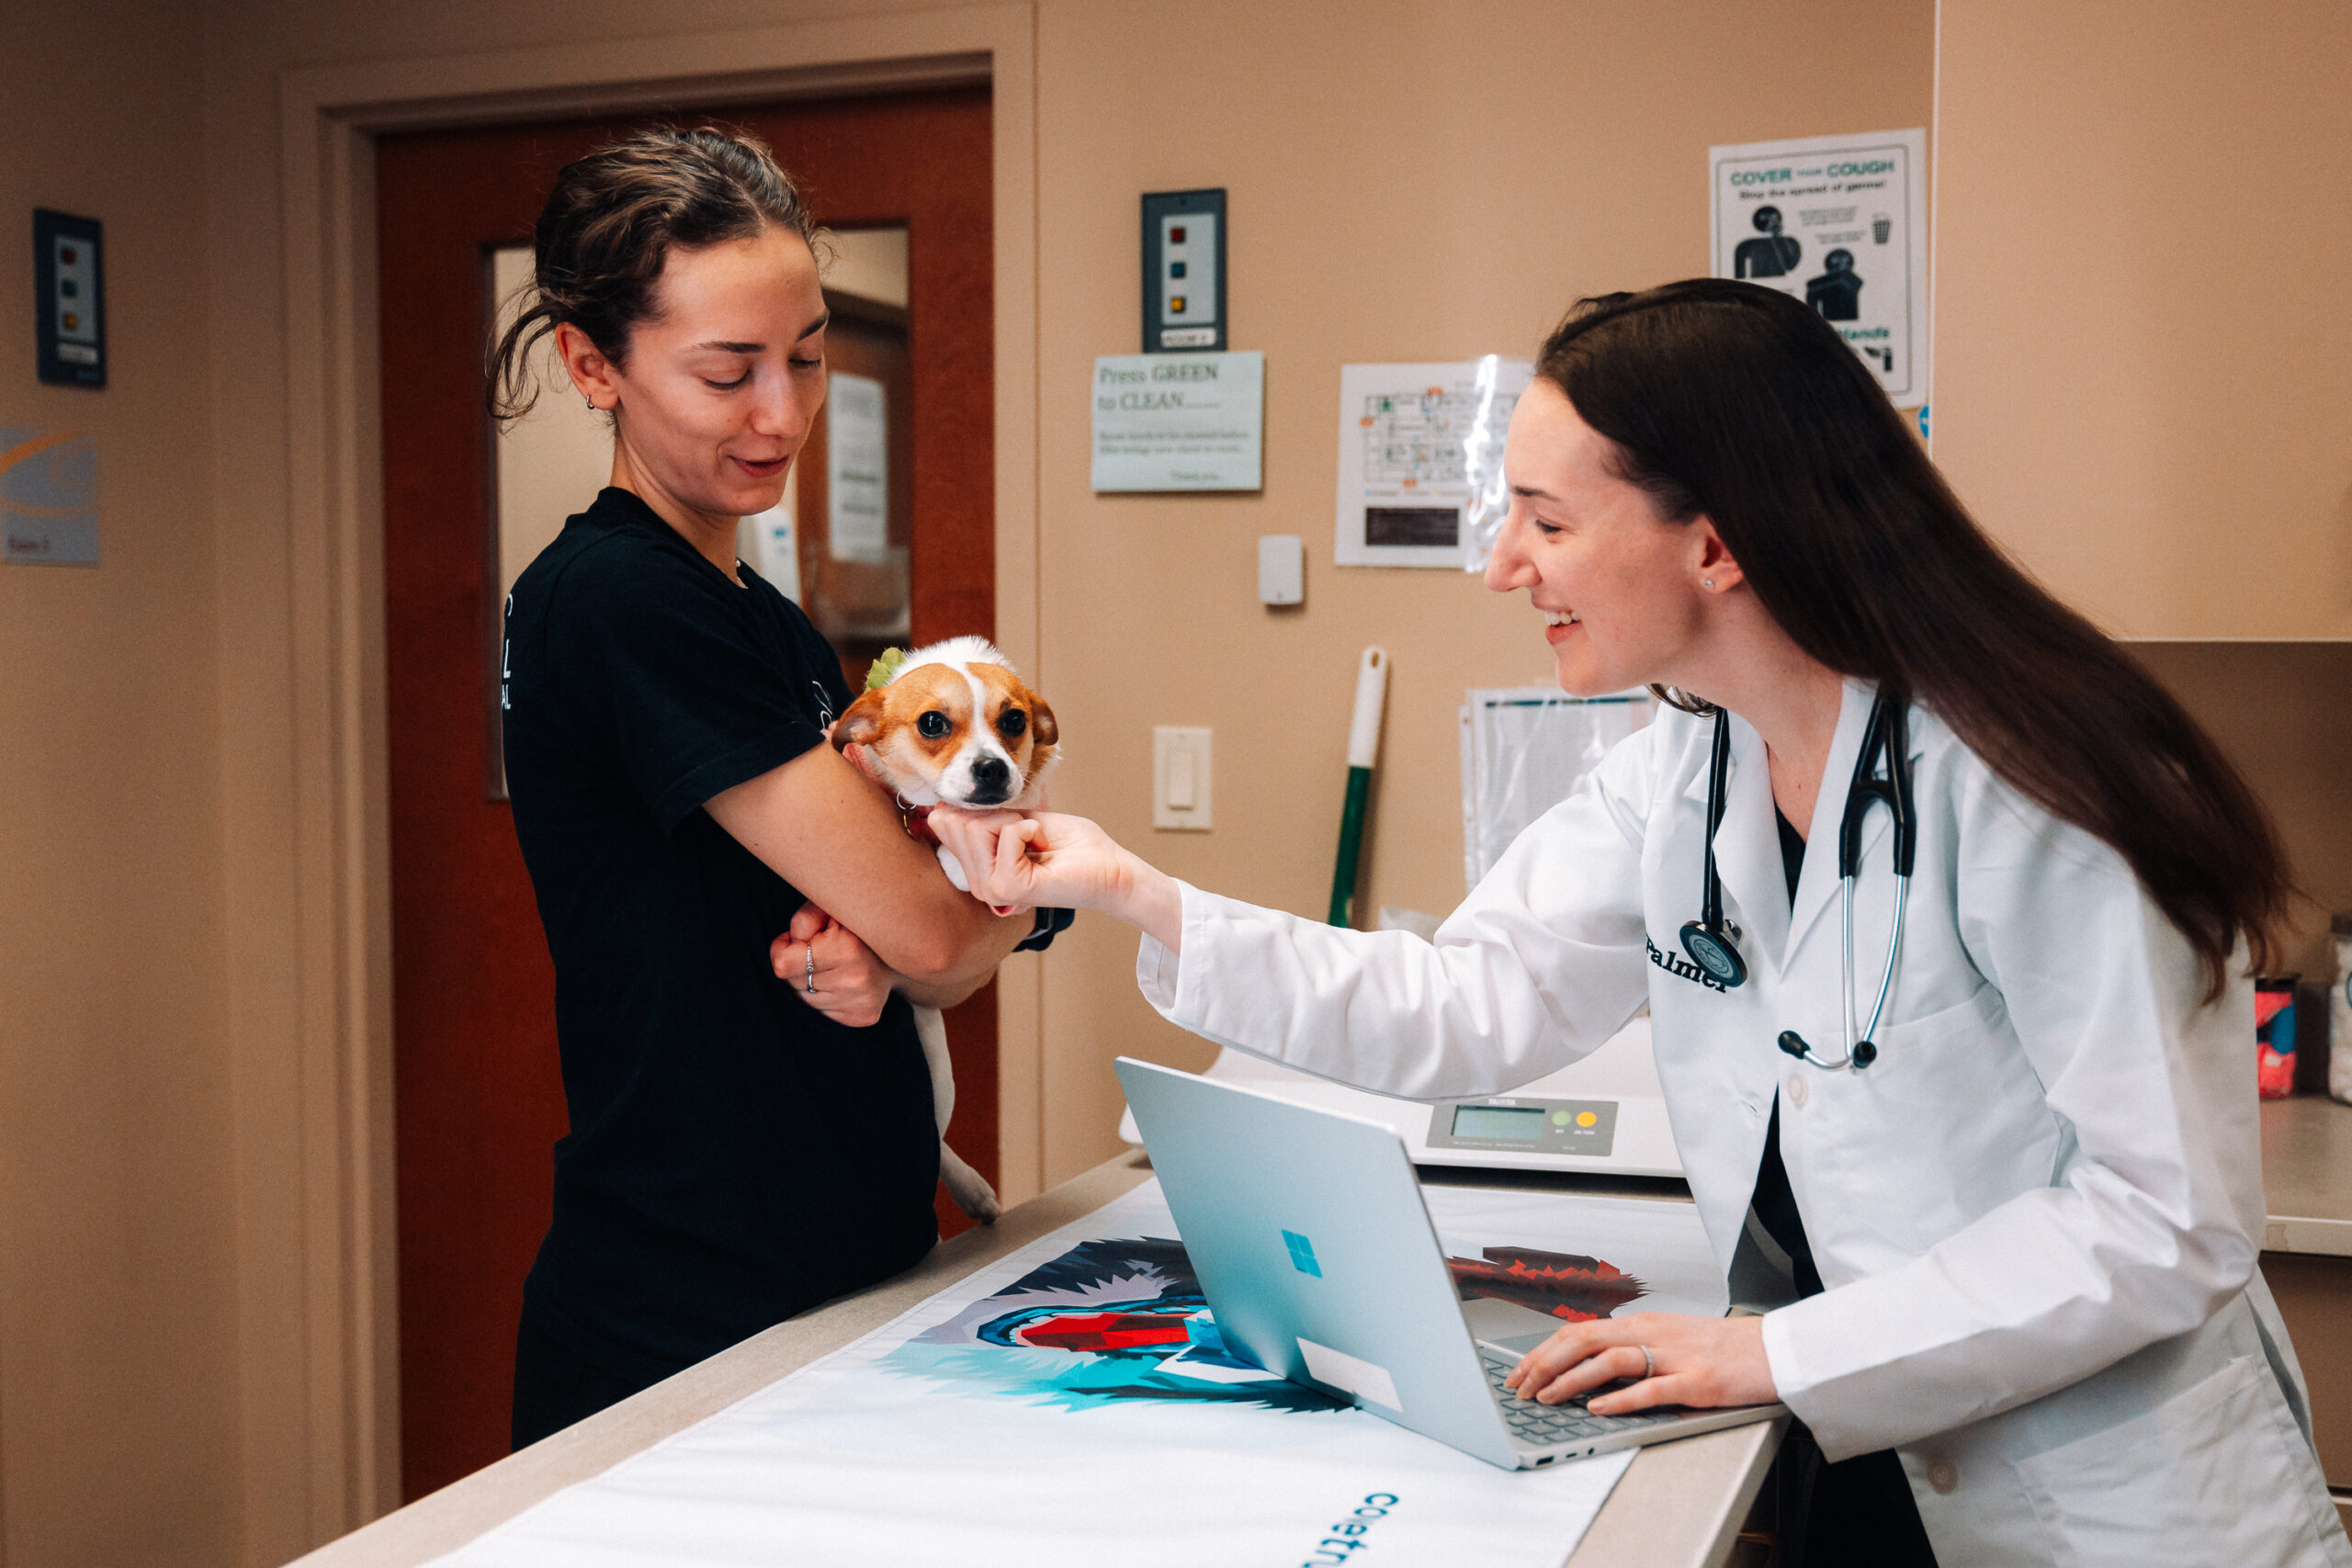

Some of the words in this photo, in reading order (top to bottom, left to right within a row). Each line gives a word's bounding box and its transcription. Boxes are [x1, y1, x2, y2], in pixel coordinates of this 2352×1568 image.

[1731, 167, 1792, 187] COVER
[1826, 160, 1895, 178] COUGH
[1768, 188, 1785, 197] the
[1789, 185, 1827, 197] spread
[1099, 367, 1147, 384] Press
[1151, 364, 1219, 383] GREEN
[1097, 396, 1117, 411] to
